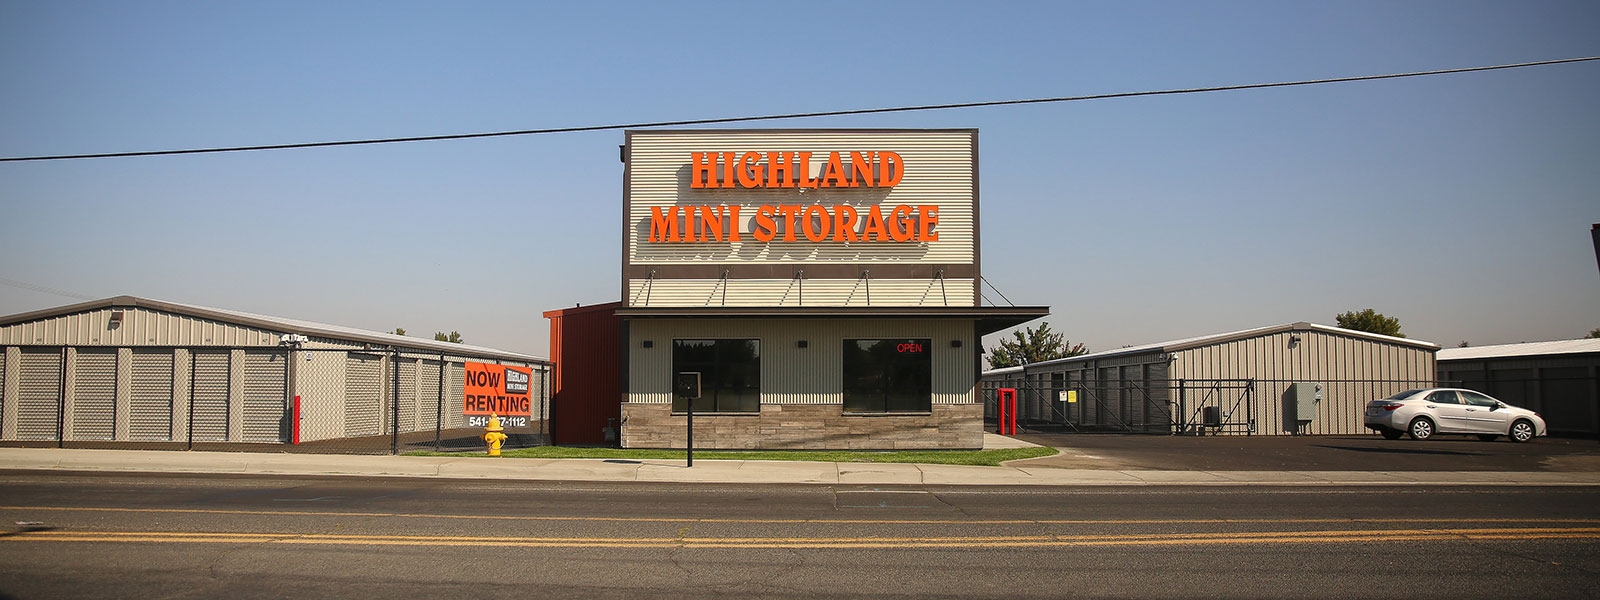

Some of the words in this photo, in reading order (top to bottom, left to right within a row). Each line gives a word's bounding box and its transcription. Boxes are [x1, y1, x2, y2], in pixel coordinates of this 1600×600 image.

[691, 151, 905, 189] HIGHLAND
[648, 205, 742, 243] MINI
[752, 204, 939, 243] STORAGE
[896, 343, 922, 353] OPEN
[466, 370, 500, 387] NOW
[466, 394, 529, 412] RENTING
[469, 416, 526, 427] 541-7-1112
